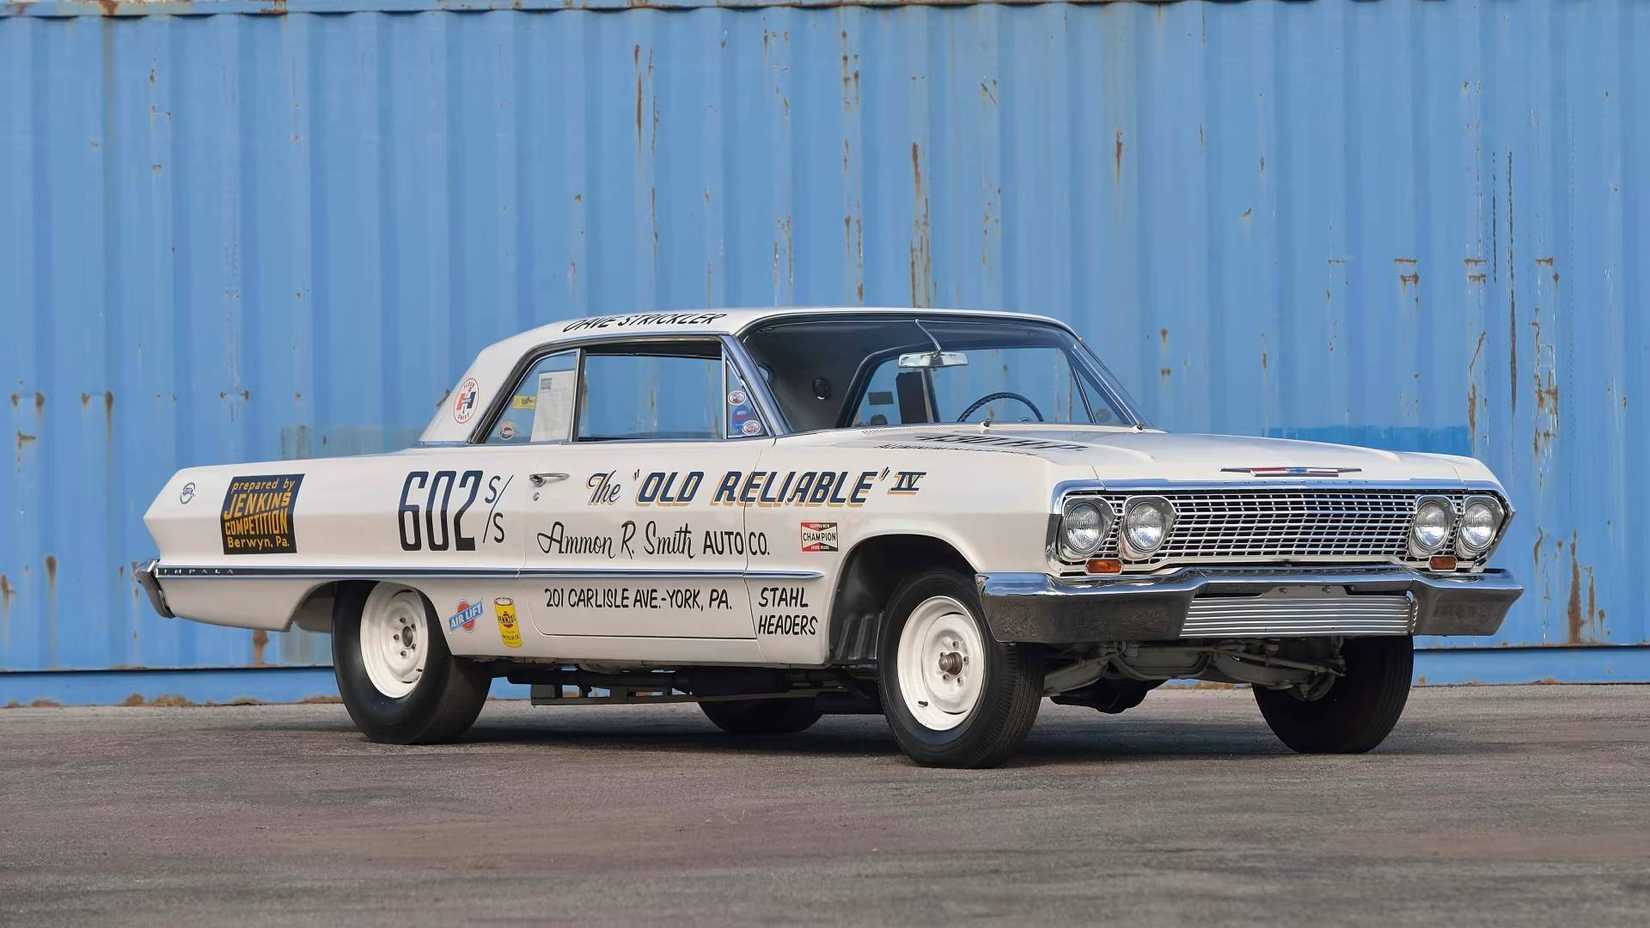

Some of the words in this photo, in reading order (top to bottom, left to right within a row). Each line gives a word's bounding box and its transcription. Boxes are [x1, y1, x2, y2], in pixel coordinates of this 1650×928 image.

[618, 312, 727, 326] STRICKLER
[231, 479, 279, 493] prepared
[283, 478, 295, 492] by
[586, 472, 621, 505] The
[888, 471, 927, 495] IV
[223, 491, 292, 520] JENKINS
[397, 470, 483, 551] 602
[224, 508, 289, 536] COMPETITION
[227, 536, 274, 550] Berwyn,
[276, 535, 290, 548] Pa.
[536, 520, 616, 558] Ammon
[620, 520, 636, 559] R.
[643, 519, 697, 558] Smith
[702, 533, 744, 557] AUTO
[749, 533, 770, 556] CO.
[802, 532, 837, 542] CHAMPION
[163, 567, 234, 575] IMPALA
[544, 588, 565, 609] 201
[567, 588, 630, 609] CARLISLE
[709, 588, 733, 610] PA.
[758, 587, 809, 608] STAHL
[449, 613, 465, 629] AIR
[465, 601, 482, 620] LIFT
[758, 615, 818, 636] HEADERS
